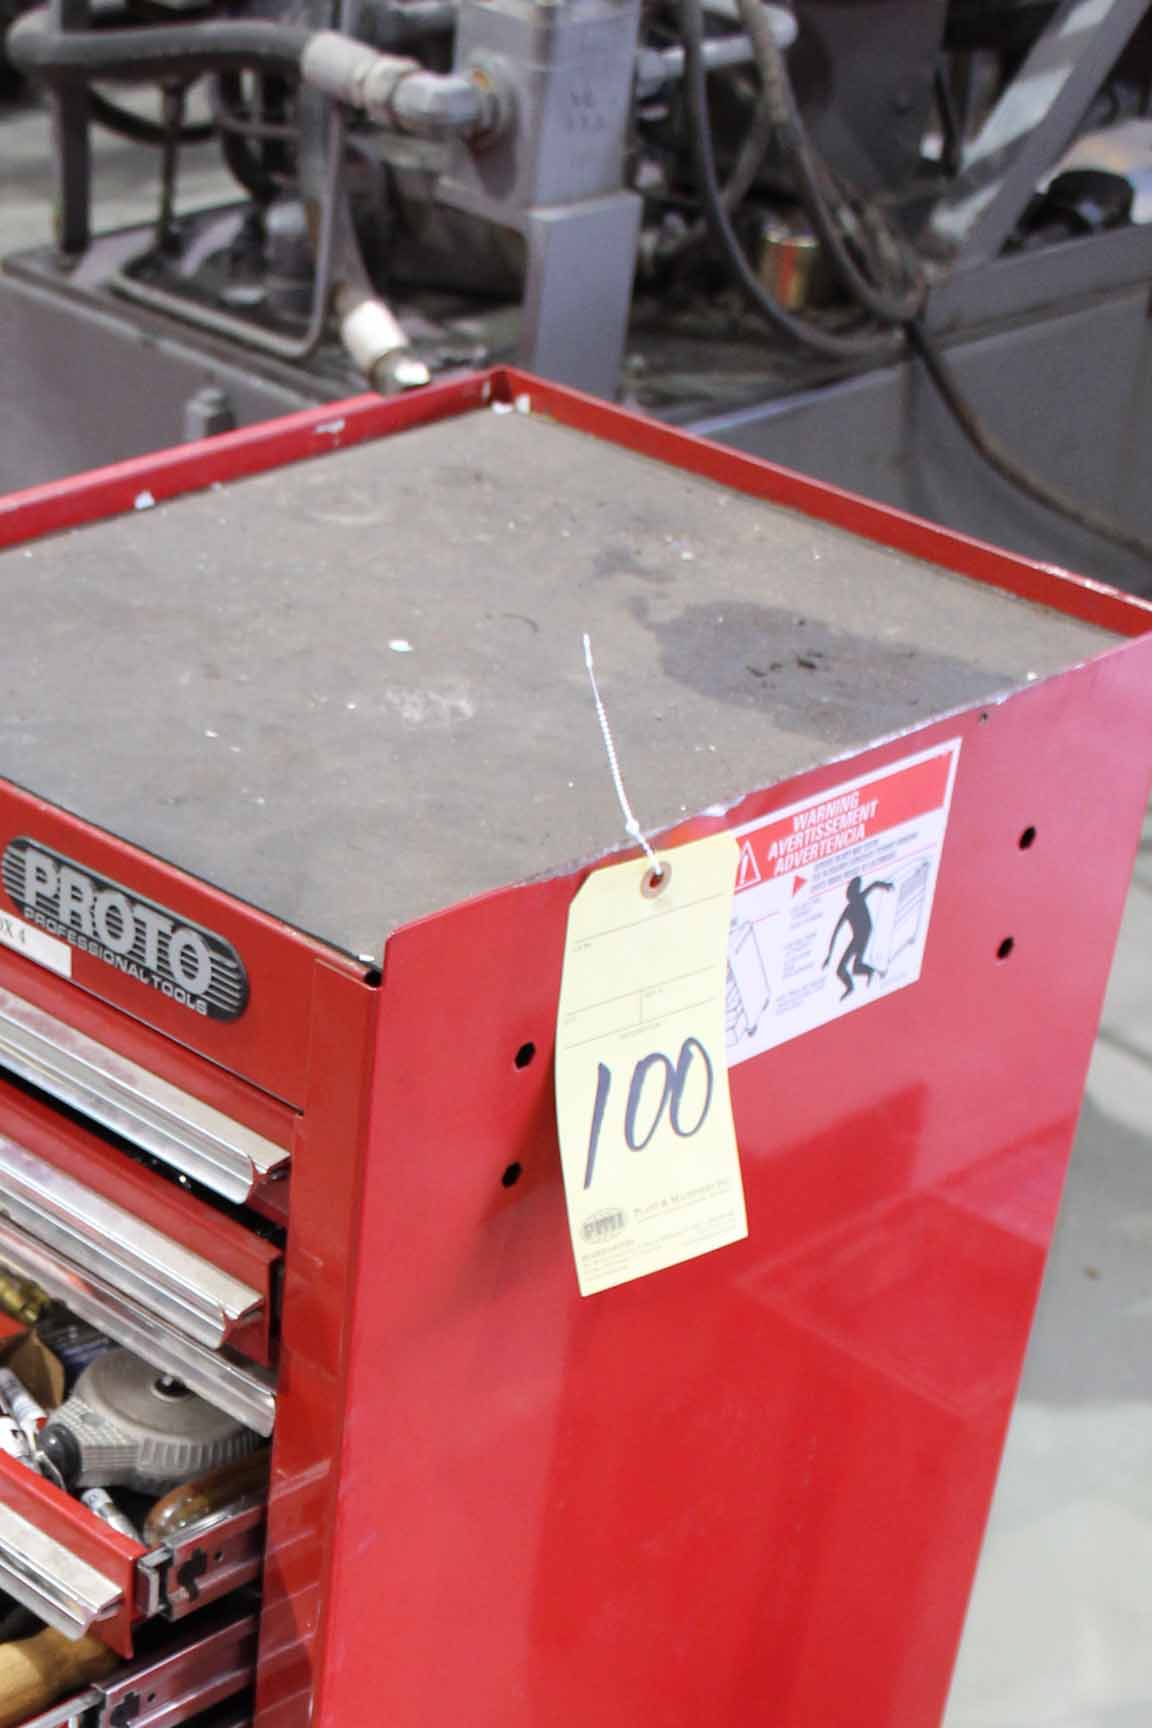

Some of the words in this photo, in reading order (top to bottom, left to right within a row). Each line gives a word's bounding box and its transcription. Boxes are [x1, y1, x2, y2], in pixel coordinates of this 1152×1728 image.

[767, 800, 879, 862] AVERTISSEMENT
[792, 792, 860, 832] WARNING
[773, 824, 866, 878] ADVERTENCIA
[18, 927, 27, 944] 4
[23, 847, 213, 998] PROTO
[24, 906, 151, 985] PROFESSIONAL
[150, 975, 209, 1016] TOOLS
[583, 1036, 715, 1191] 100
